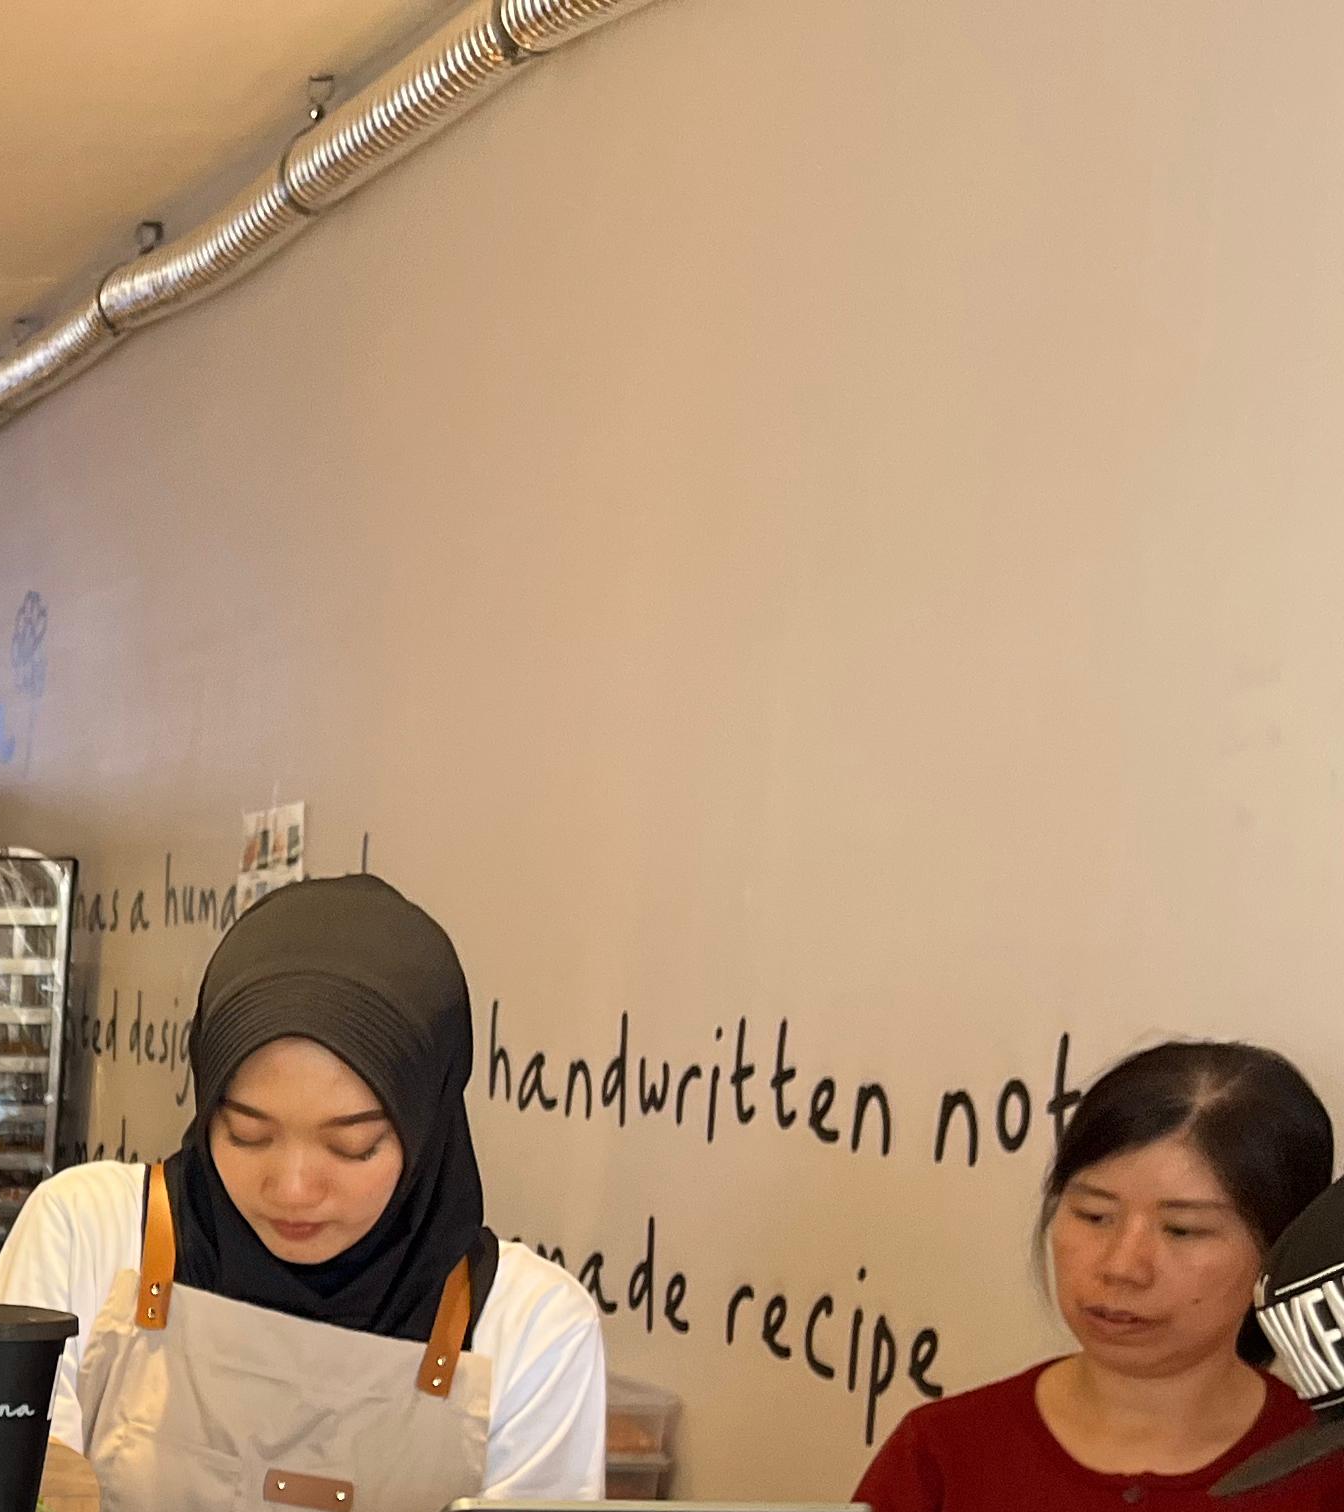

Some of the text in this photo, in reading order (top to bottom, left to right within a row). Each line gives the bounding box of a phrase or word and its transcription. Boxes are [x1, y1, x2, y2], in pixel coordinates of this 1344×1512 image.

[129, 889, 150, 935] a
[489, 1000, 892, 1156] handwritten
[726, 1267, 944, 1445] recipe
